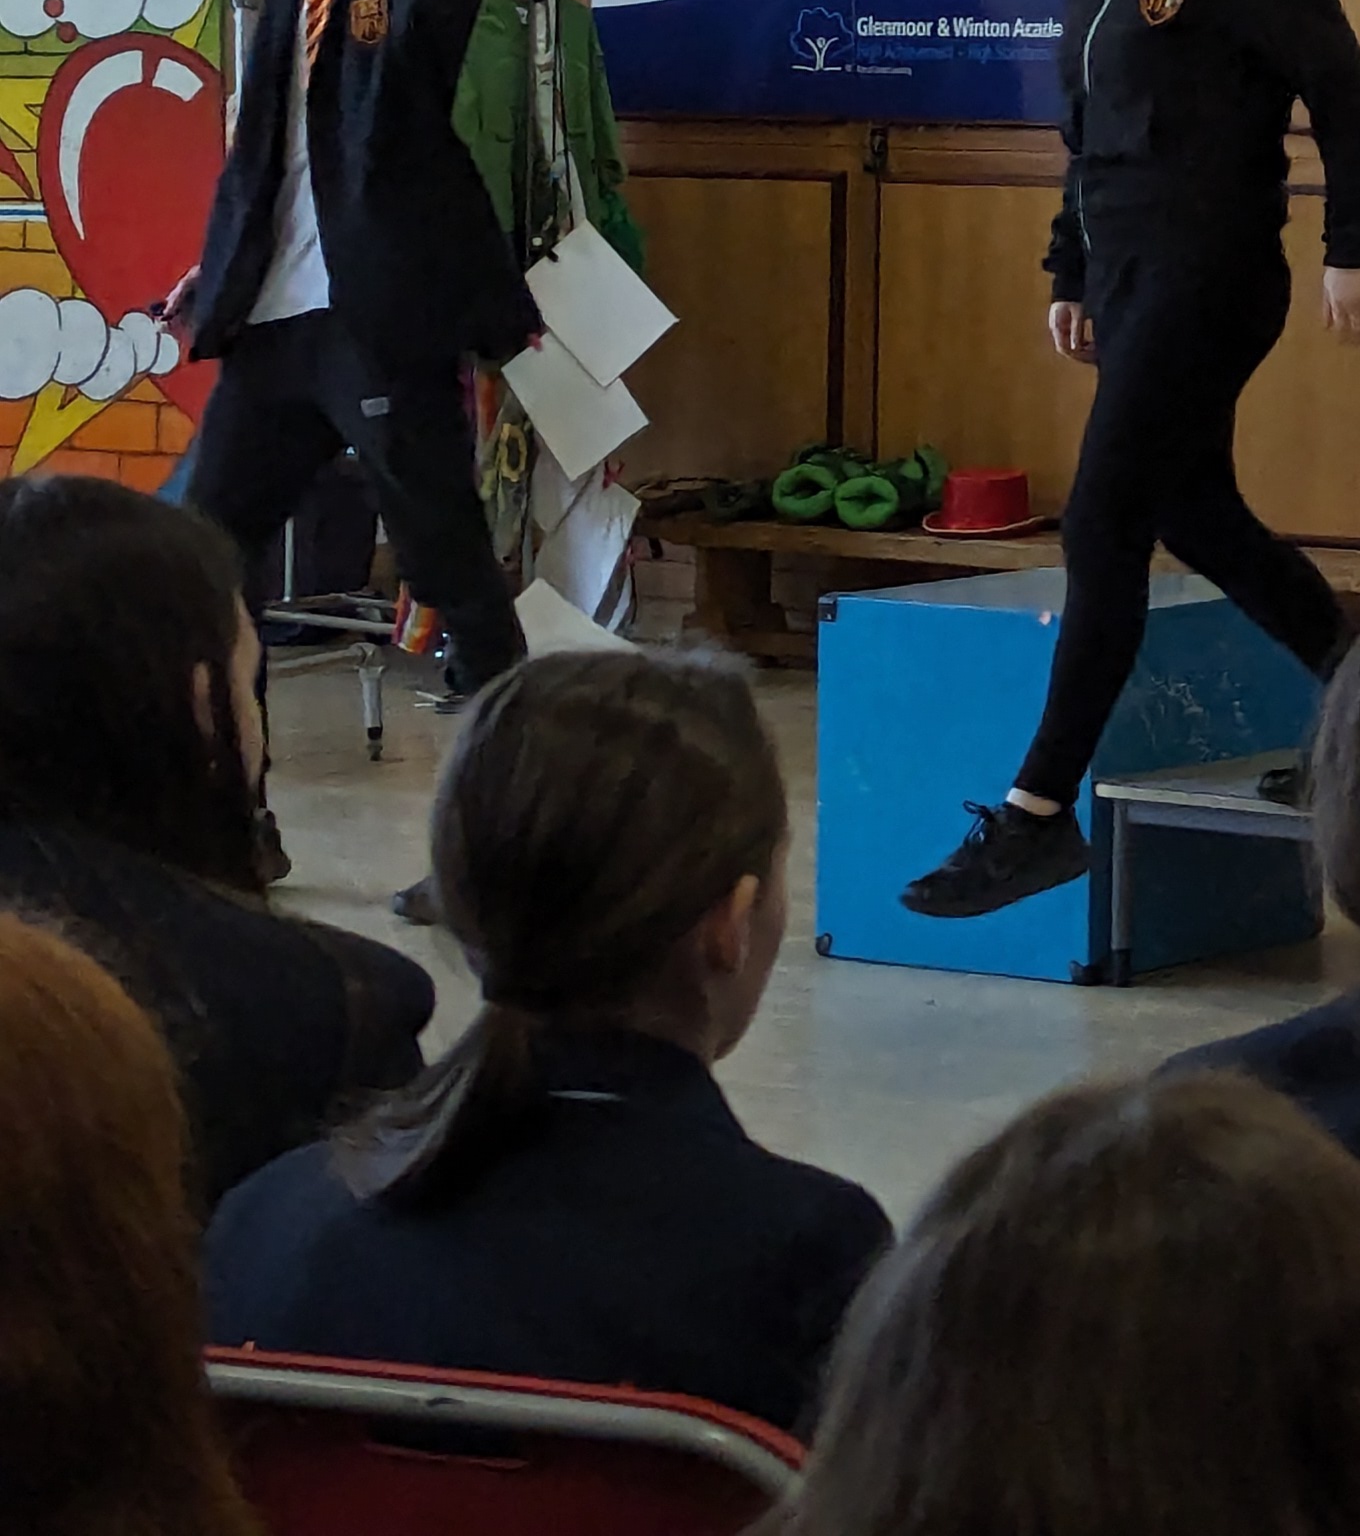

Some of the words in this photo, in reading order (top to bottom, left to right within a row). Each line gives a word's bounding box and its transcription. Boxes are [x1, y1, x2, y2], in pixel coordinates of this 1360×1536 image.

[856, 15, 934, 37] Glenmoor
[937, 16, 950, 38] &
[952, 16, 1010, 38] Winton
